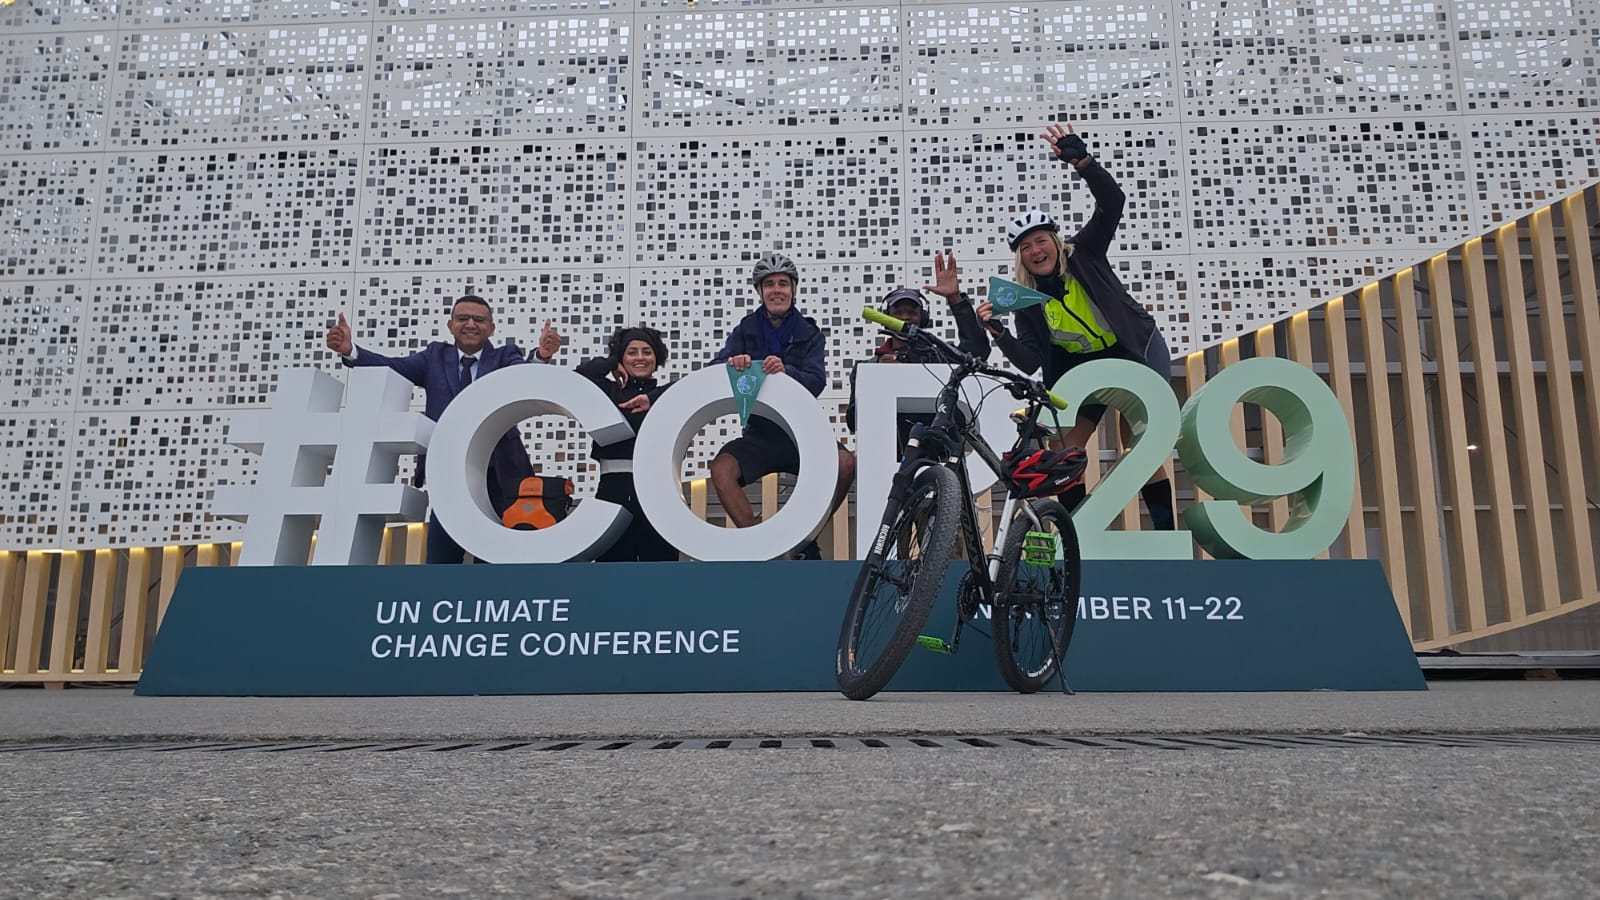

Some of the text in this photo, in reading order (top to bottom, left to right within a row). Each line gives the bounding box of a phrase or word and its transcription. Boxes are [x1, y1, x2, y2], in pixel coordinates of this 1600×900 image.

[211, 357, 1355, 566] #COP29
[376, 598, 570, 624] UN CLIMATE
[973, 596, 1153, 620] NMBER
[371, 629, 740, 658] CHANGE CONFERENCE
